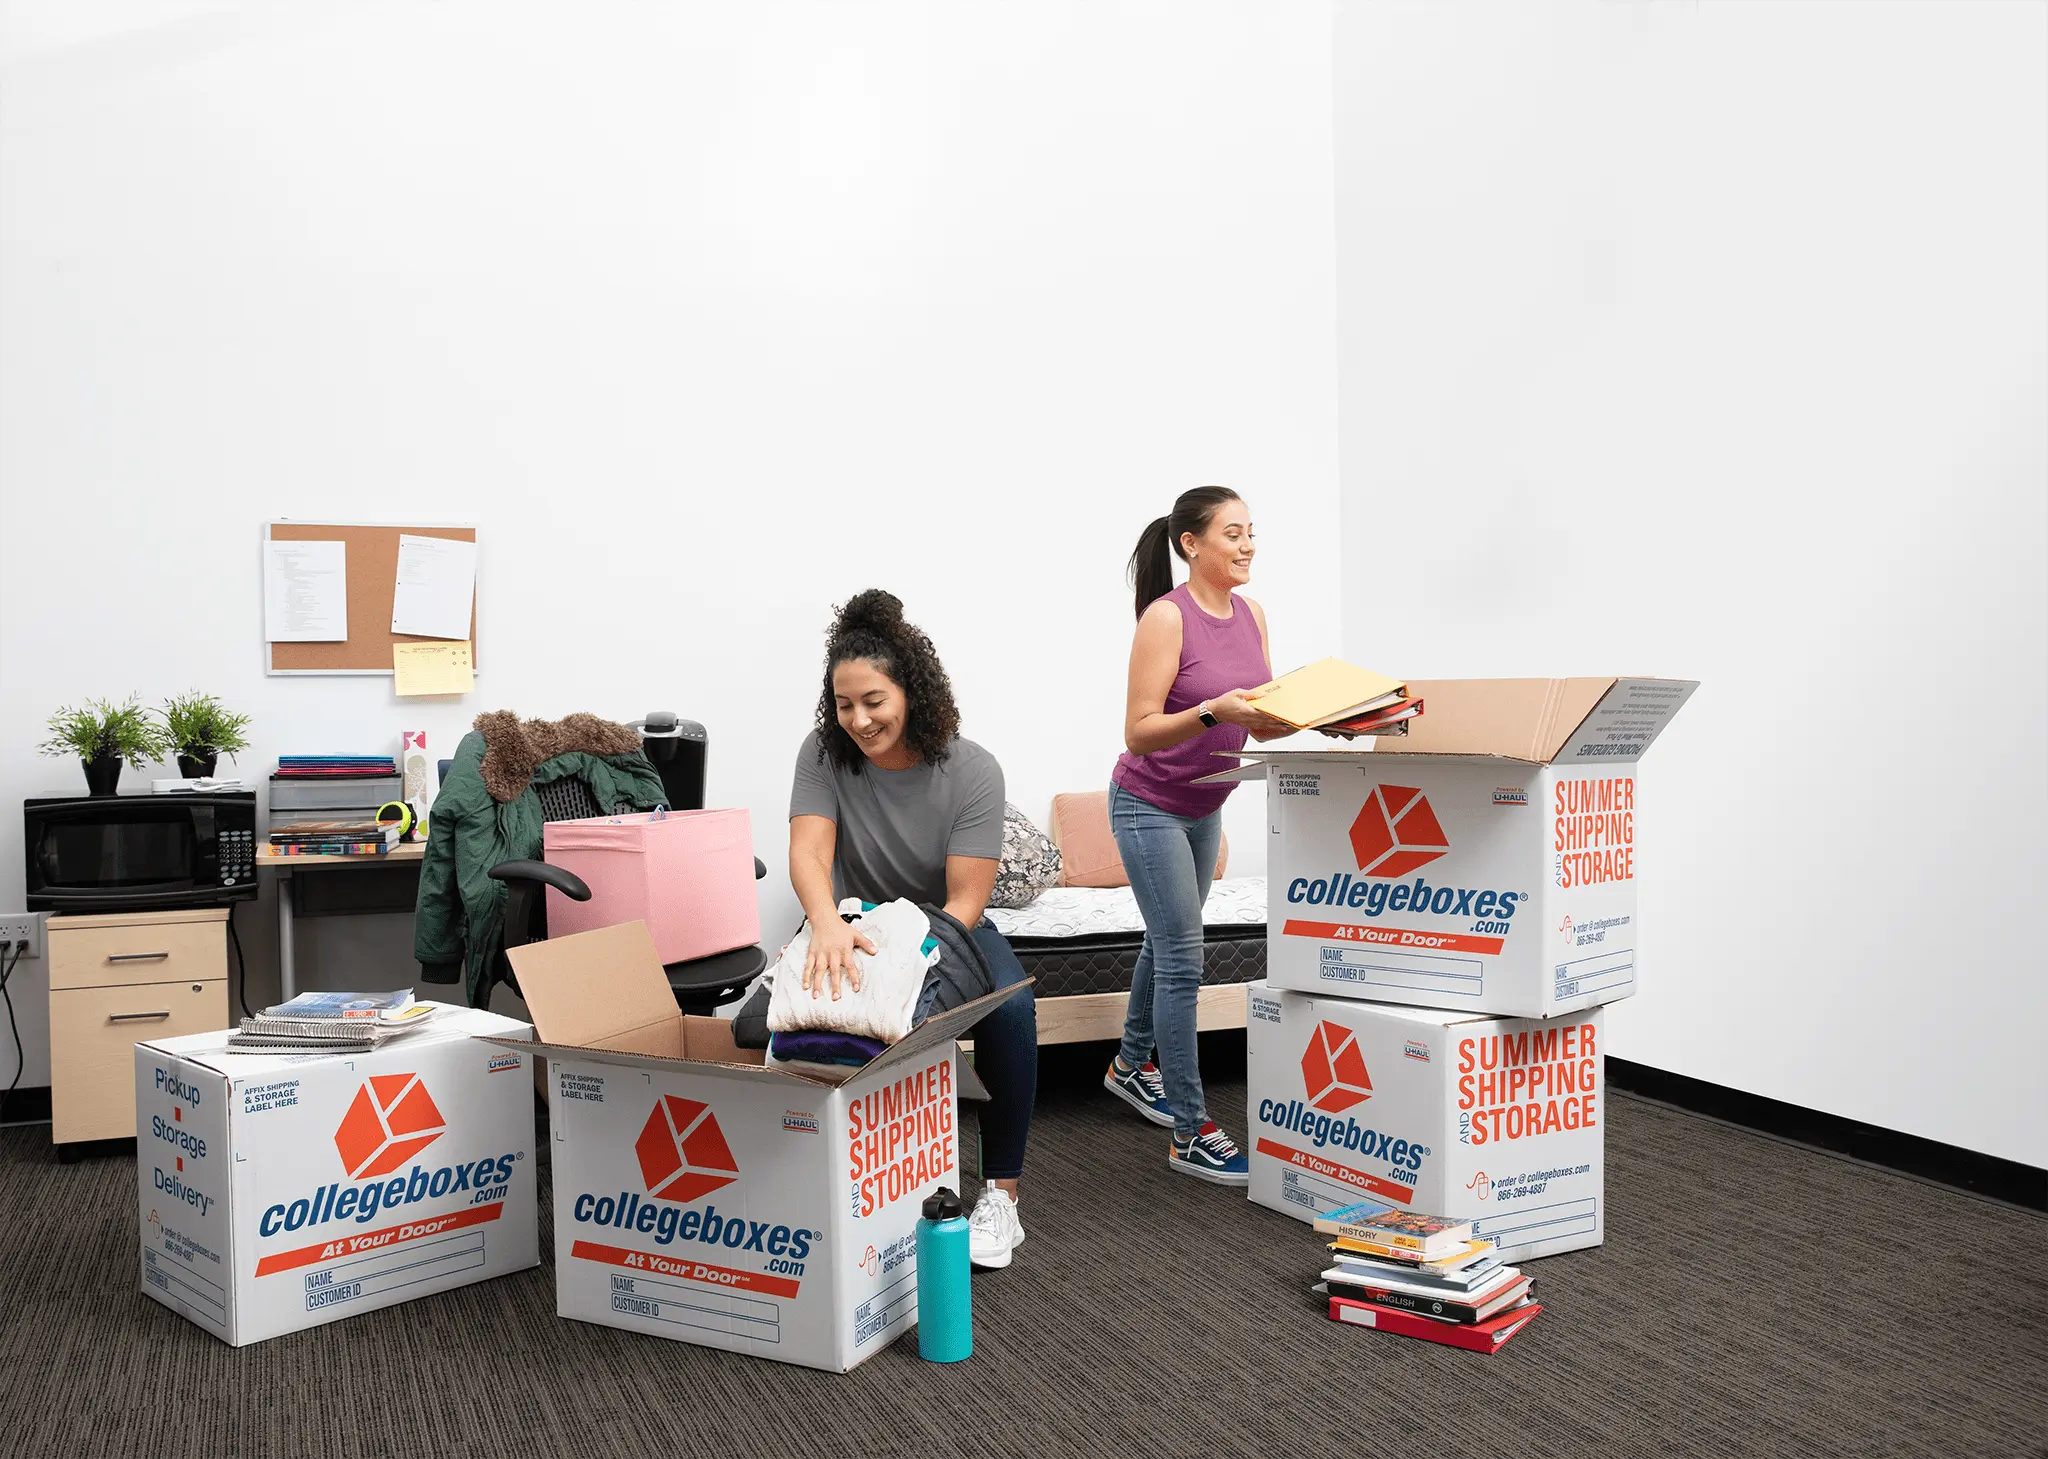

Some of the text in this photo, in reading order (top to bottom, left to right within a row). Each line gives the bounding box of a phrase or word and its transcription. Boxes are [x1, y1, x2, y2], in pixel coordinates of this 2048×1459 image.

[1576, 743, 1644, 756] PACKING GUIDELINES
[1286, 780, 1317, 788] STORAGE
[1555, 778, 1633, 815] SUMMER
[1555, 812, 1633, 852] SHIPPING
[1562, 847, 1633, 889] STORAGE
[1334, 926, 1352, 939] At
[1358, 928, 1397, 943] Your
[1469, 920, 1511, 935] .com
[1577, 923, 1588, 934] order
[1322, 949, 1343, 961] NAME
[1322, 965, 1365, 981] CUSTOMER ID
[1253, 1011, 1281, 1023] LABEL HERE
[1258, 1005, 1279, 1015] STORAGE
[1405, 1047, 1429, 1057] U-HAUL
[1458, 1024, 1595, 1073] SUMMER
[489, 1058, 520, 1068] U-HAUL
[561, 1073, 604, 1084] AFFIX SHIPPING
[568, 1082, 600, 1092] STORAGE
[1458, 1059, 1595, 1110] SHIPPING
[155, 1067, 200, 1108] Pickup
[244, 1080, 300, 1095] AFFIX SHIPPING
[561, 1090, 604, 1102] LABEL HERE
[245, 1089, 295, 1104] & STORAGE
[245, 1097, 298, 1113] LABEL HERE
[848, 1060, 951, 1140] SUMMER
[785, 1109, 807, 1117] Powered
[1471, 1094, 1595, 1145] STORAGE
[784, 1118, 817, 1128] U-HAUL
[1459, 1112, 1469, 1144] AND
[152, 1115, 206, 1159] Storage
[849, 1097, 951, 1181] SHIPPING
[1291, 1151, 1306, 1165] At
[1308, 1156, 1336, 1175] Your
[860, 1135, 953, 1217] STORAGE
[1284, 1170, 1299, 1185] NAME
[1388, 1168, 1418, 1185] .com
[1497, 1164, 1590, 1188] order @ collegeboxes.com
[469, 1184, 508, 1205] .com
[852, 1183, 860, 1218] AND
[1284, 1186, 1315, 1207] CUSTOMER ID
[1497, 1183, 1547, 1201] 866-269-4887
[164, 1227, 176, 1239] order
[1339, 1226, 1377, 1239] HISTORY
[320, 1242, 343, 1259] At
[350, 1231, 395, 1251] Your
[883, 1244, 897, 1259] order
[898, 1237, 905, 1249] @
[624, 1253, 644, 1267] At
[650, 1257, 690, 1275] Your
[764, 1258, 805, 1276] .com
[307, 1272, 332, 1288] NAME
[613, 1277, 635, 1292] NAME
[308, 1283, 361, 1308] CUSTOMER ID
[1376, 1293, 1415, 1308] ENGLISH
[614, 1296, 659, 1316] CUSTOMER ID
[857, 1302, 871, 1323] NAME
[857, 1315, 882, 1343] CUSTOMER
